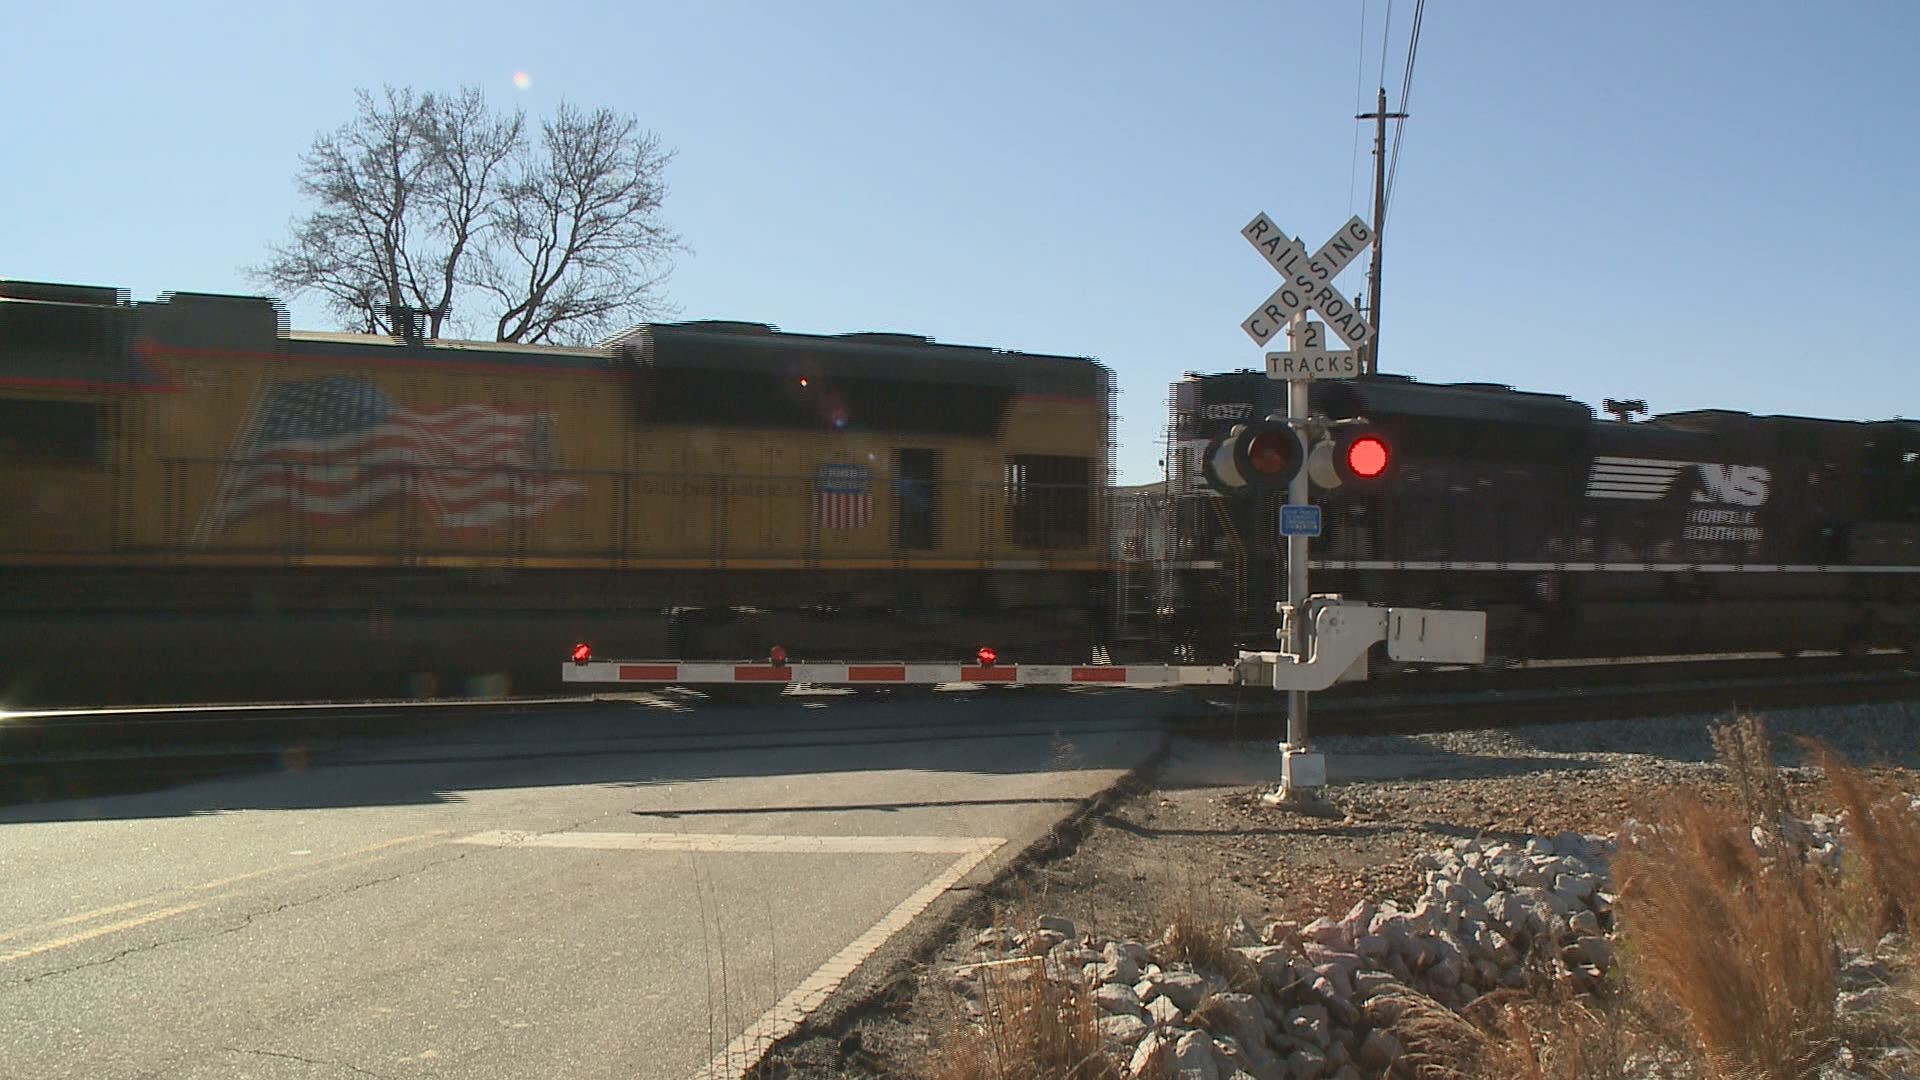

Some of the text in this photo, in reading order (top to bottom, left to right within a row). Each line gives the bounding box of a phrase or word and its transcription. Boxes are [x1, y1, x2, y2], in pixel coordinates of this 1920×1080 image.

[1250, 223, 1368, 338] CROSSING
[1304, 328, 1318, 347] 2
[1270, 356, 1353, 373] TRACKS
